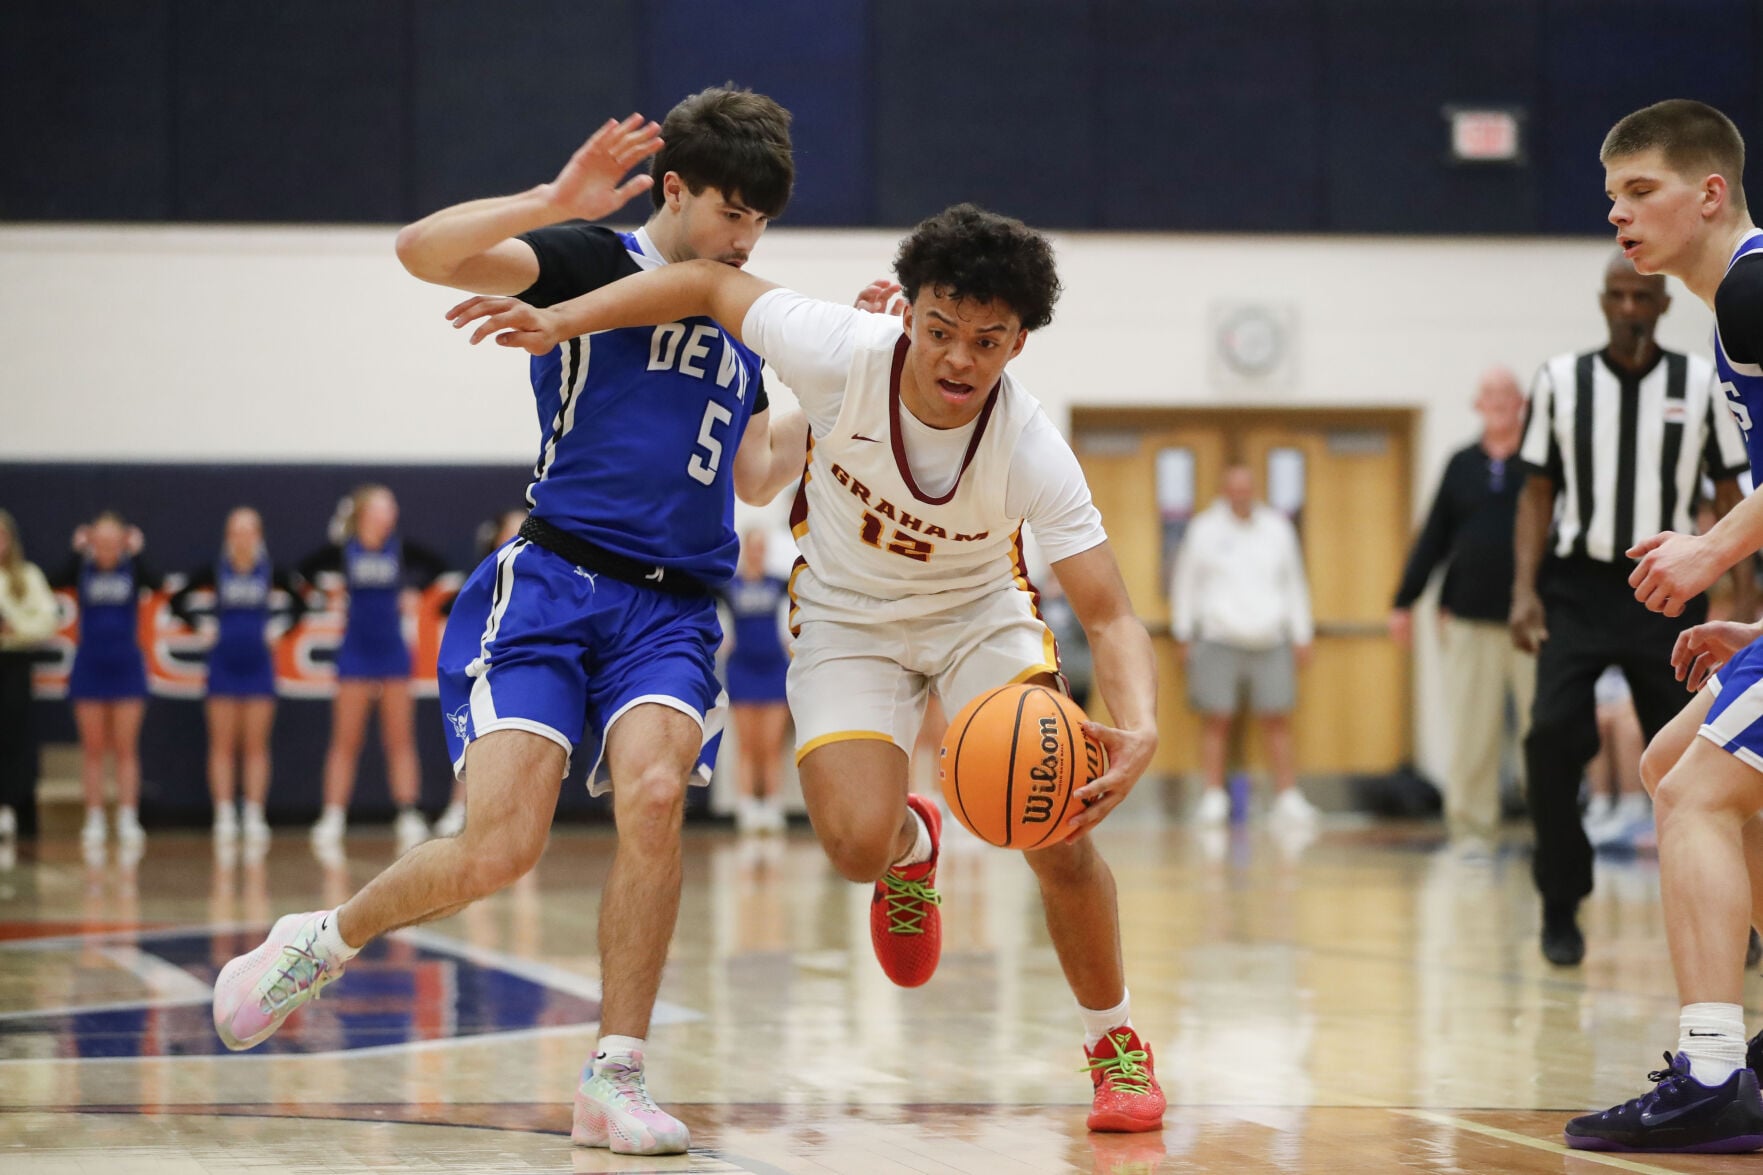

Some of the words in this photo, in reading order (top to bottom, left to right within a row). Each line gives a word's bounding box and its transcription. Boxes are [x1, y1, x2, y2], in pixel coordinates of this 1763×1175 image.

[647, 321, 749, 406] DEVI
[687, 400, 733, 485] 5
[831, 462, 990, 542] GRAHAM
[859, 509, 935, 563] 12
[1021, 717, 1059, 825] Wilson
